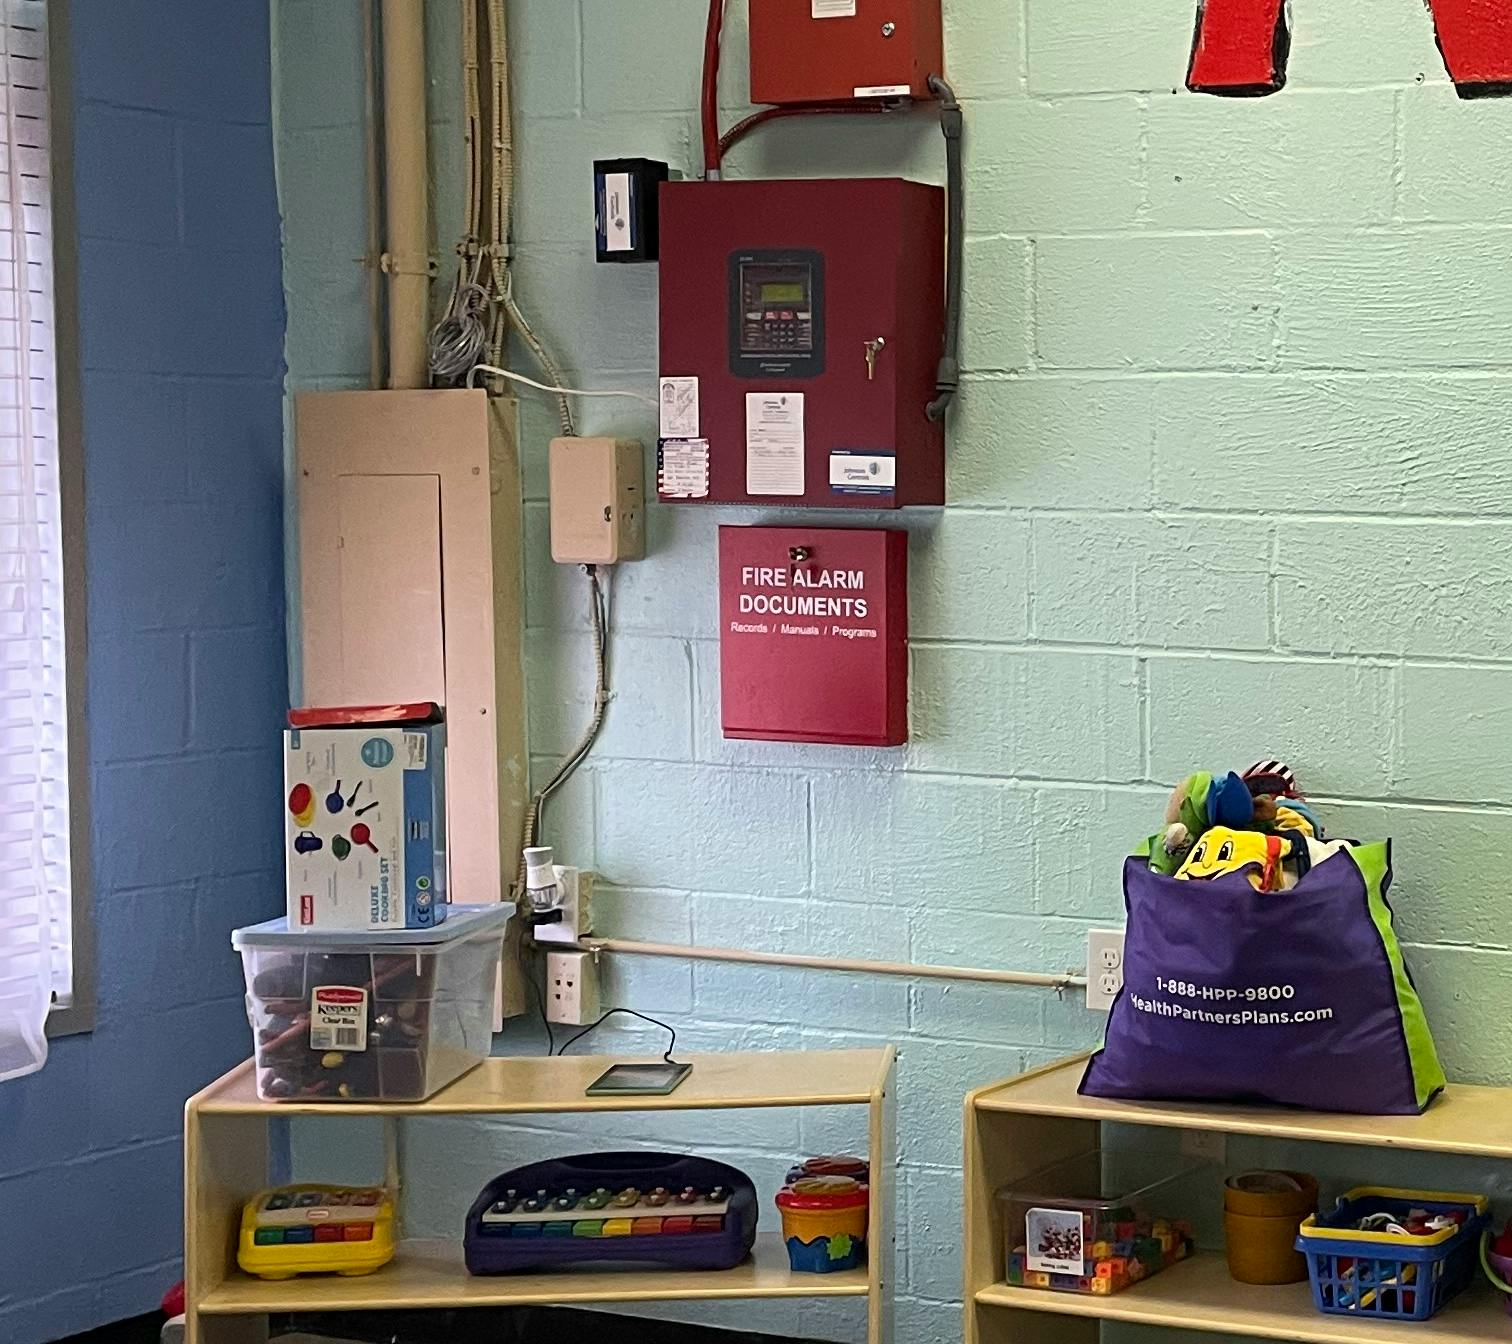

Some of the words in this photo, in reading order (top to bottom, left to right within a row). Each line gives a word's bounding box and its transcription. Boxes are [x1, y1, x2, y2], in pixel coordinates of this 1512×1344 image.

[741, 567, 787, 587] FIRE
[792, 568, 864, 590] ALARM
[739, 594, 868, 618] DOCUMENTS
[730, 621, 768, 634] Records
[780, 623, 820, 636] Manuals
[832, 625, 878, 640] Programs
[370, 884, 379, 924] DELUXE
[1156, 976, 1295, 1001] 1-888-HPP-9800
[1130, 992, 1333, 1025] HealthPartnersPlans.com
